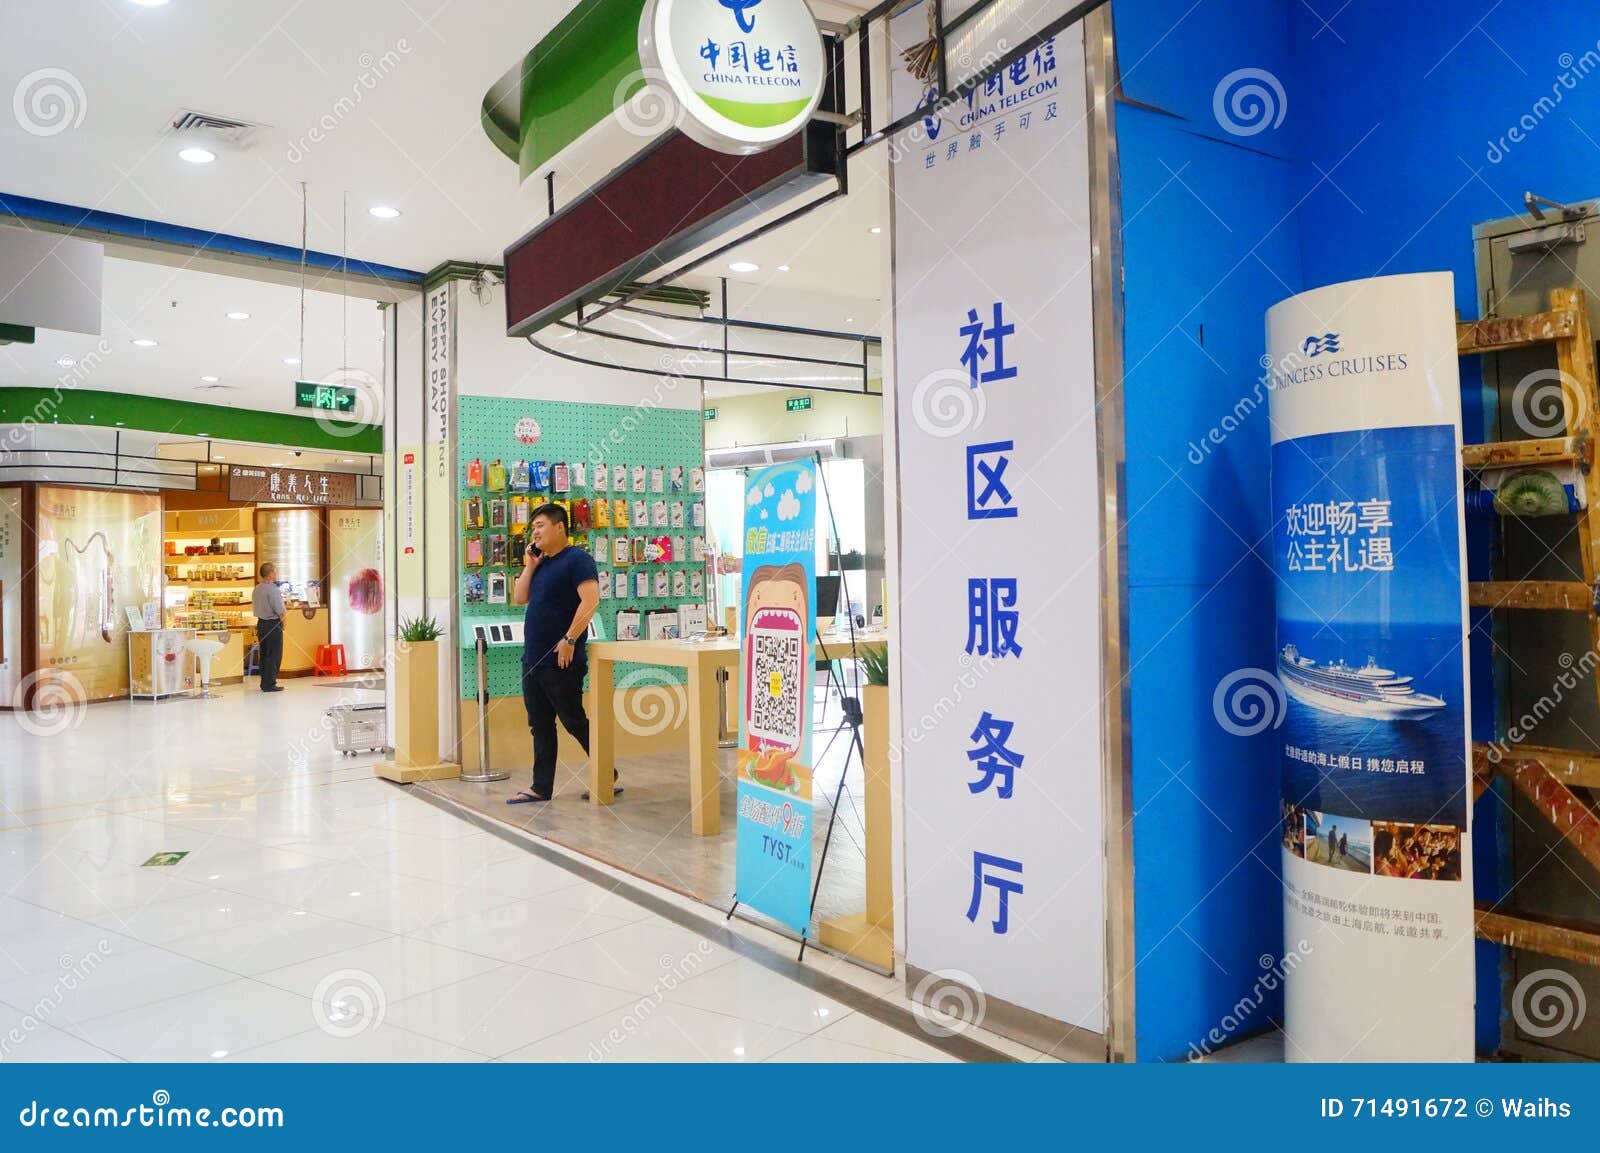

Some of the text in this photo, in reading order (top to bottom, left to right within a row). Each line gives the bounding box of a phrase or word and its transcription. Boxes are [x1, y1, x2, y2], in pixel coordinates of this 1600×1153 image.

[700, 38, 799, 72] 中国电信
[703, 73, 801, 87] CHINA TELECOM
[1000, 77, 1058, 109] TELECOM
[925, 101, 1058, 169] 世界触手可及
[1328, 354, 1408, 377] CRUISES
[439, 367, 447, 477] SHOPPING
[270, 473, 329, 495] 康美人生
[1286, 498, 1393, 538] 欢迎畅享
[1287, 537, 1395, 574] 公主礼遇
[959, 301, 1025, 935] 社区服务厅
[1367, 757, 1425, 775] 携您启程
[762, 834, 792, 863] TYST
